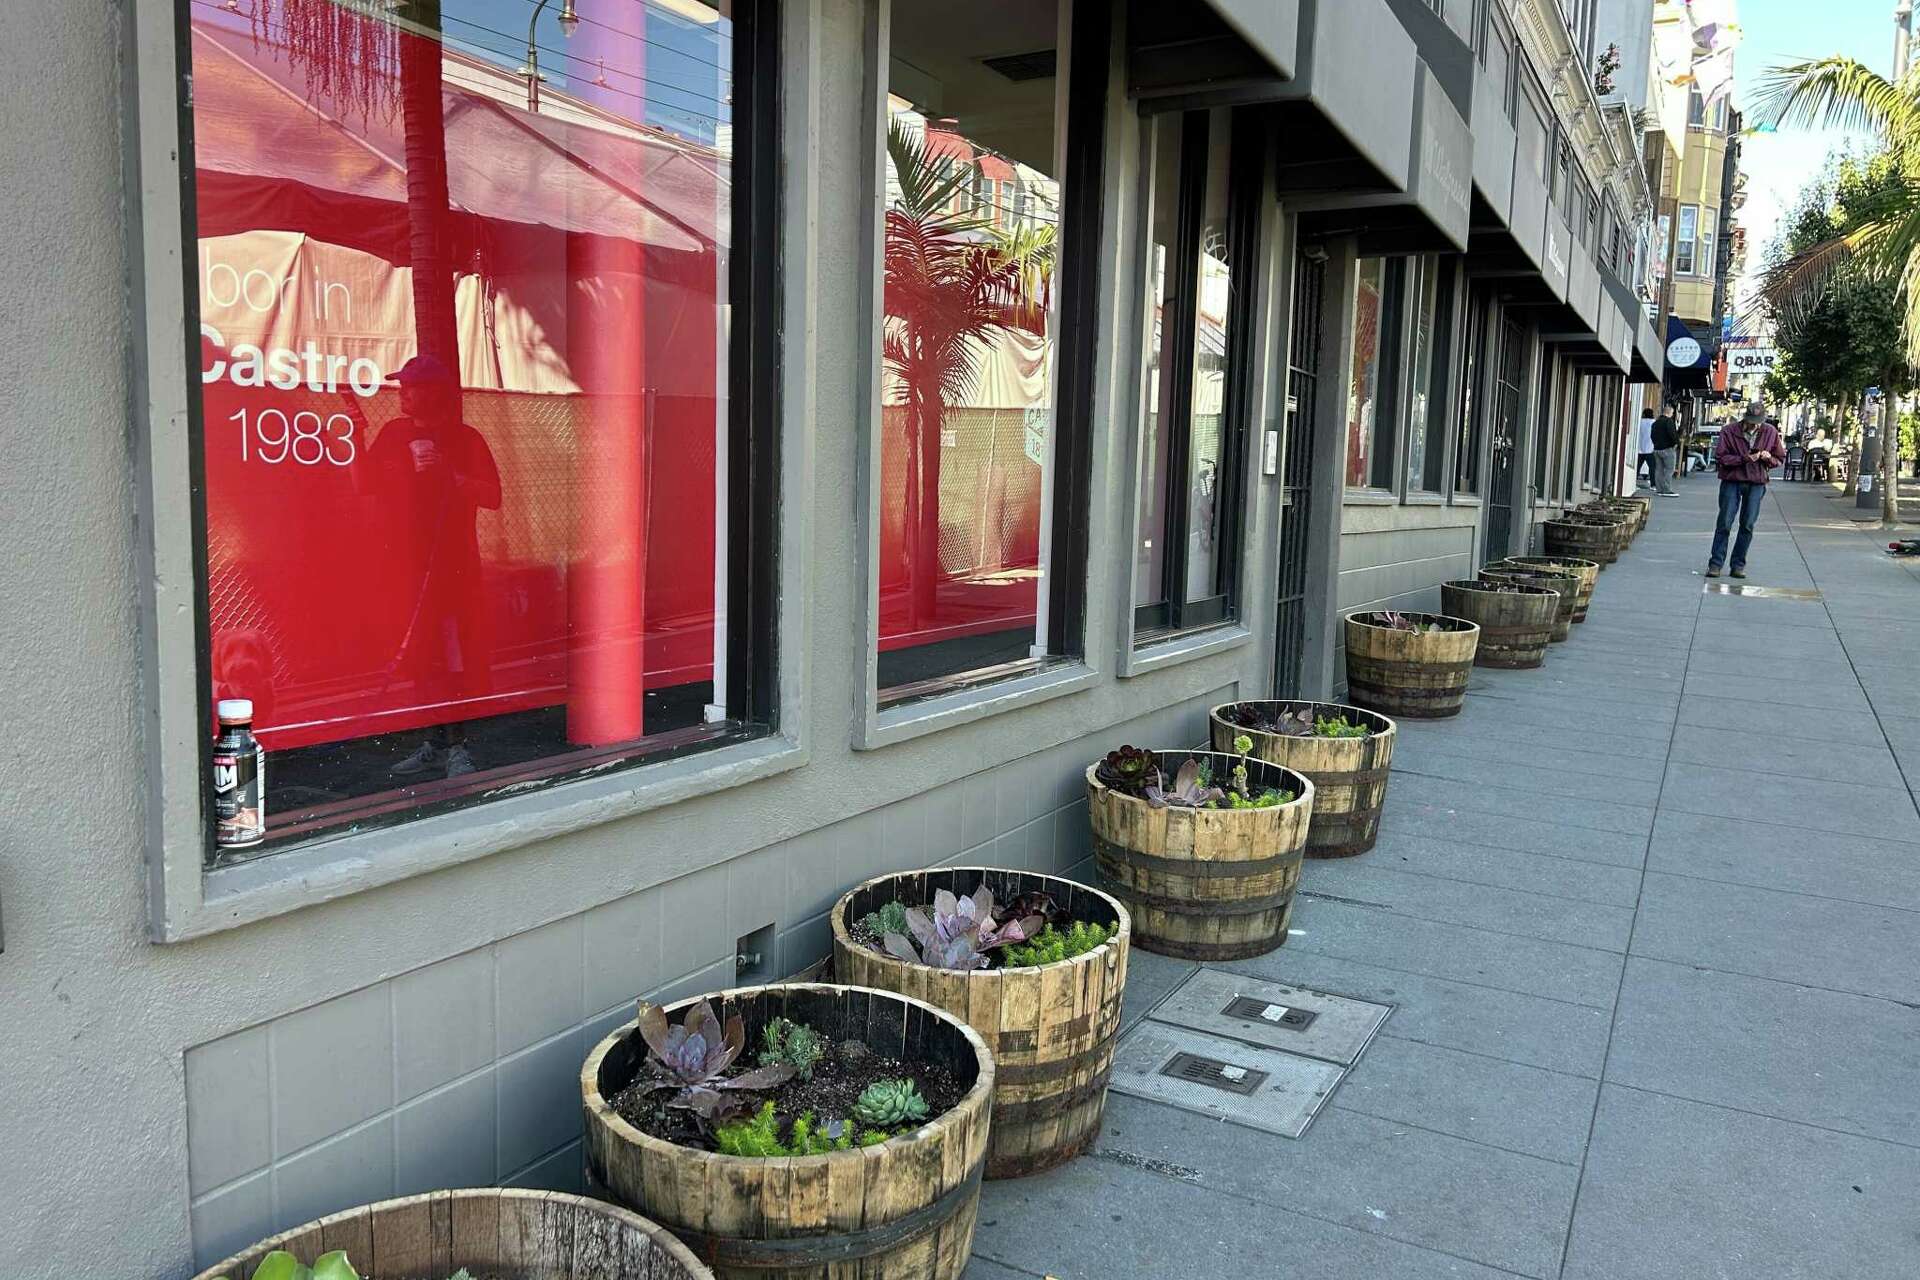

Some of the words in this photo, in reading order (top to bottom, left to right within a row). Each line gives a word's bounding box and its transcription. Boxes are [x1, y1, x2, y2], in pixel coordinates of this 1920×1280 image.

[315, 265, 351, 324] in
[200, 323, 381, 397] Castro
[1734, 355, 1775, 369] QBAR
[229, 407, 356, 466] 1983
